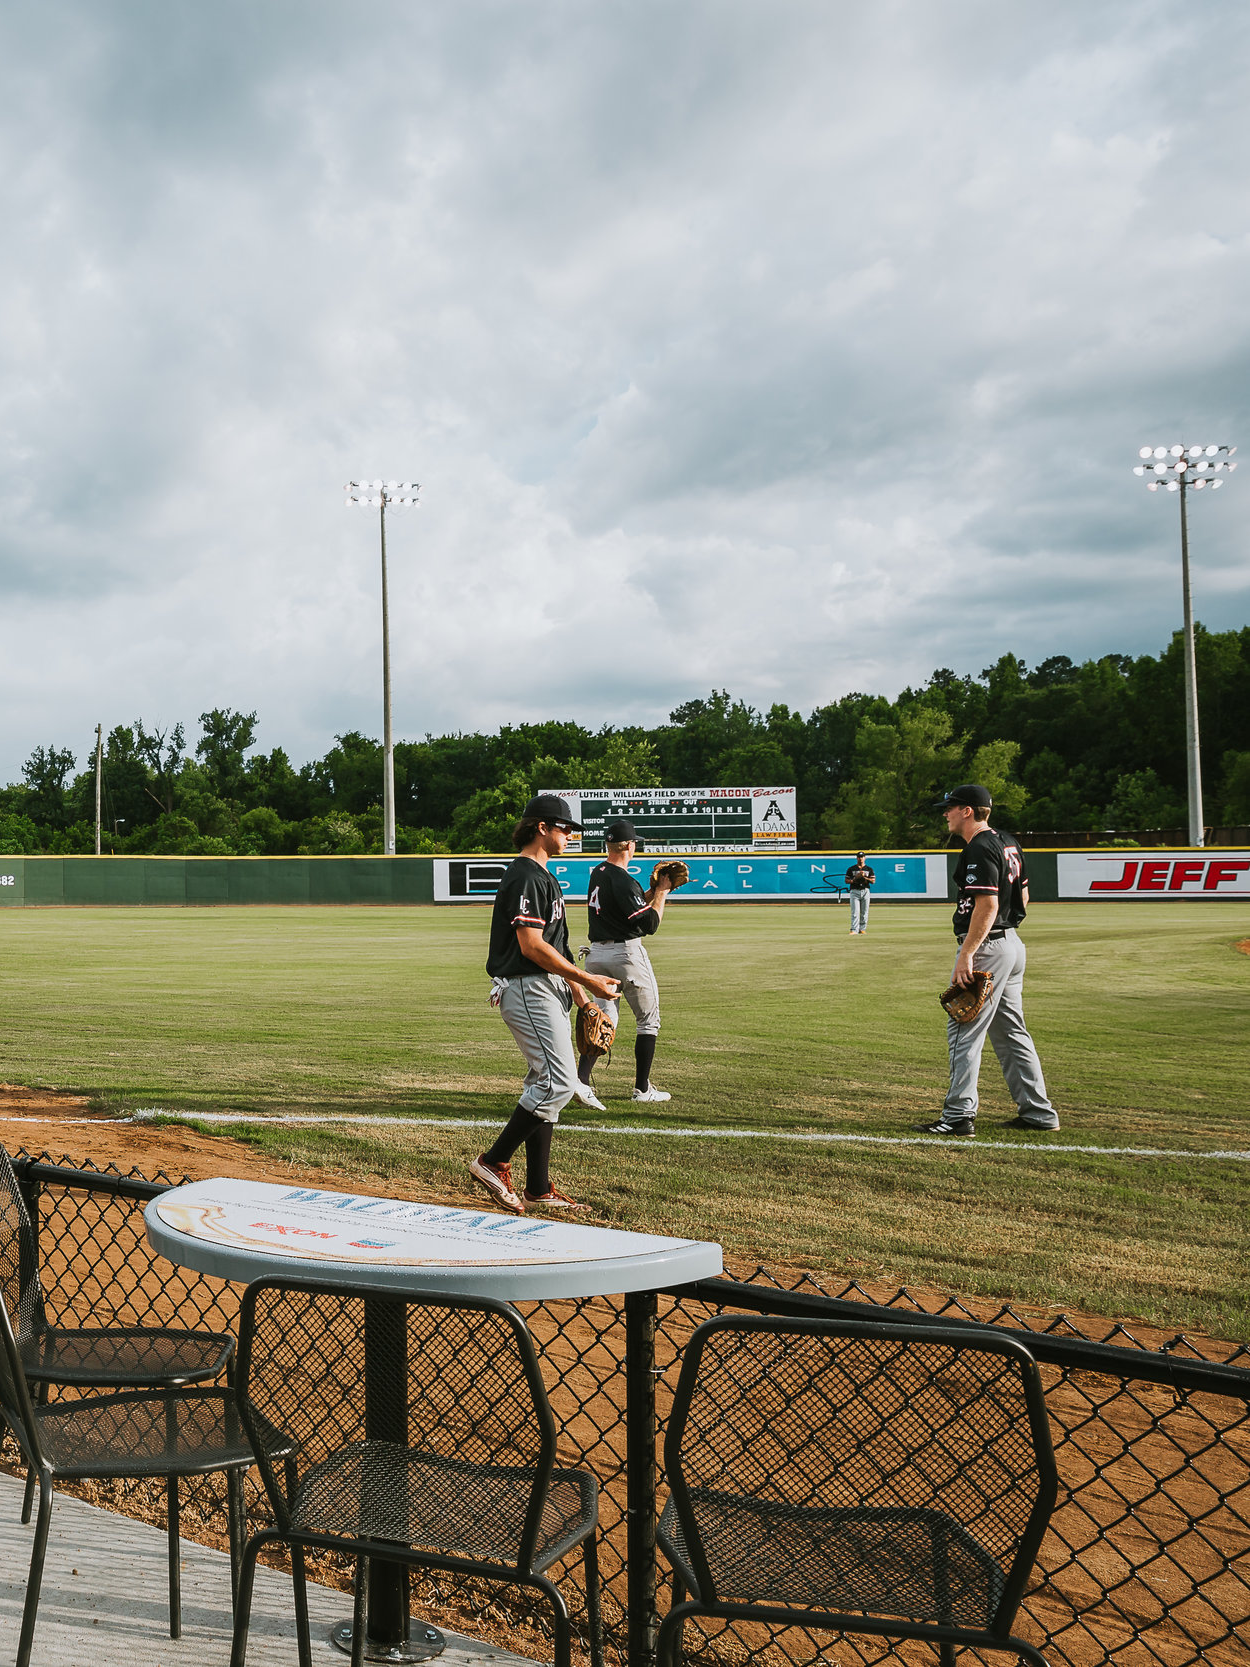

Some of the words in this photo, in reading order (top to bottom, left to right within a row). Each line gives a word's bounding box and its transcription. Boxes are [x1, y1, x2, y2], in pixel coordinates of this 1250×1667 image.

[579, 791, 610, 799] LUTHER
[613, 790, 653, 798] WILLIAMS
[654, 790, 676, 798] FIELD
[710, 789, 750, 797] MACON
[752, 788, 795, 798] Bacon
[754, 822, 796, 832] ADAMS
[1089, 861, 1250, 891] JEFF
[248, 1222, 339, 1240] EXXON
